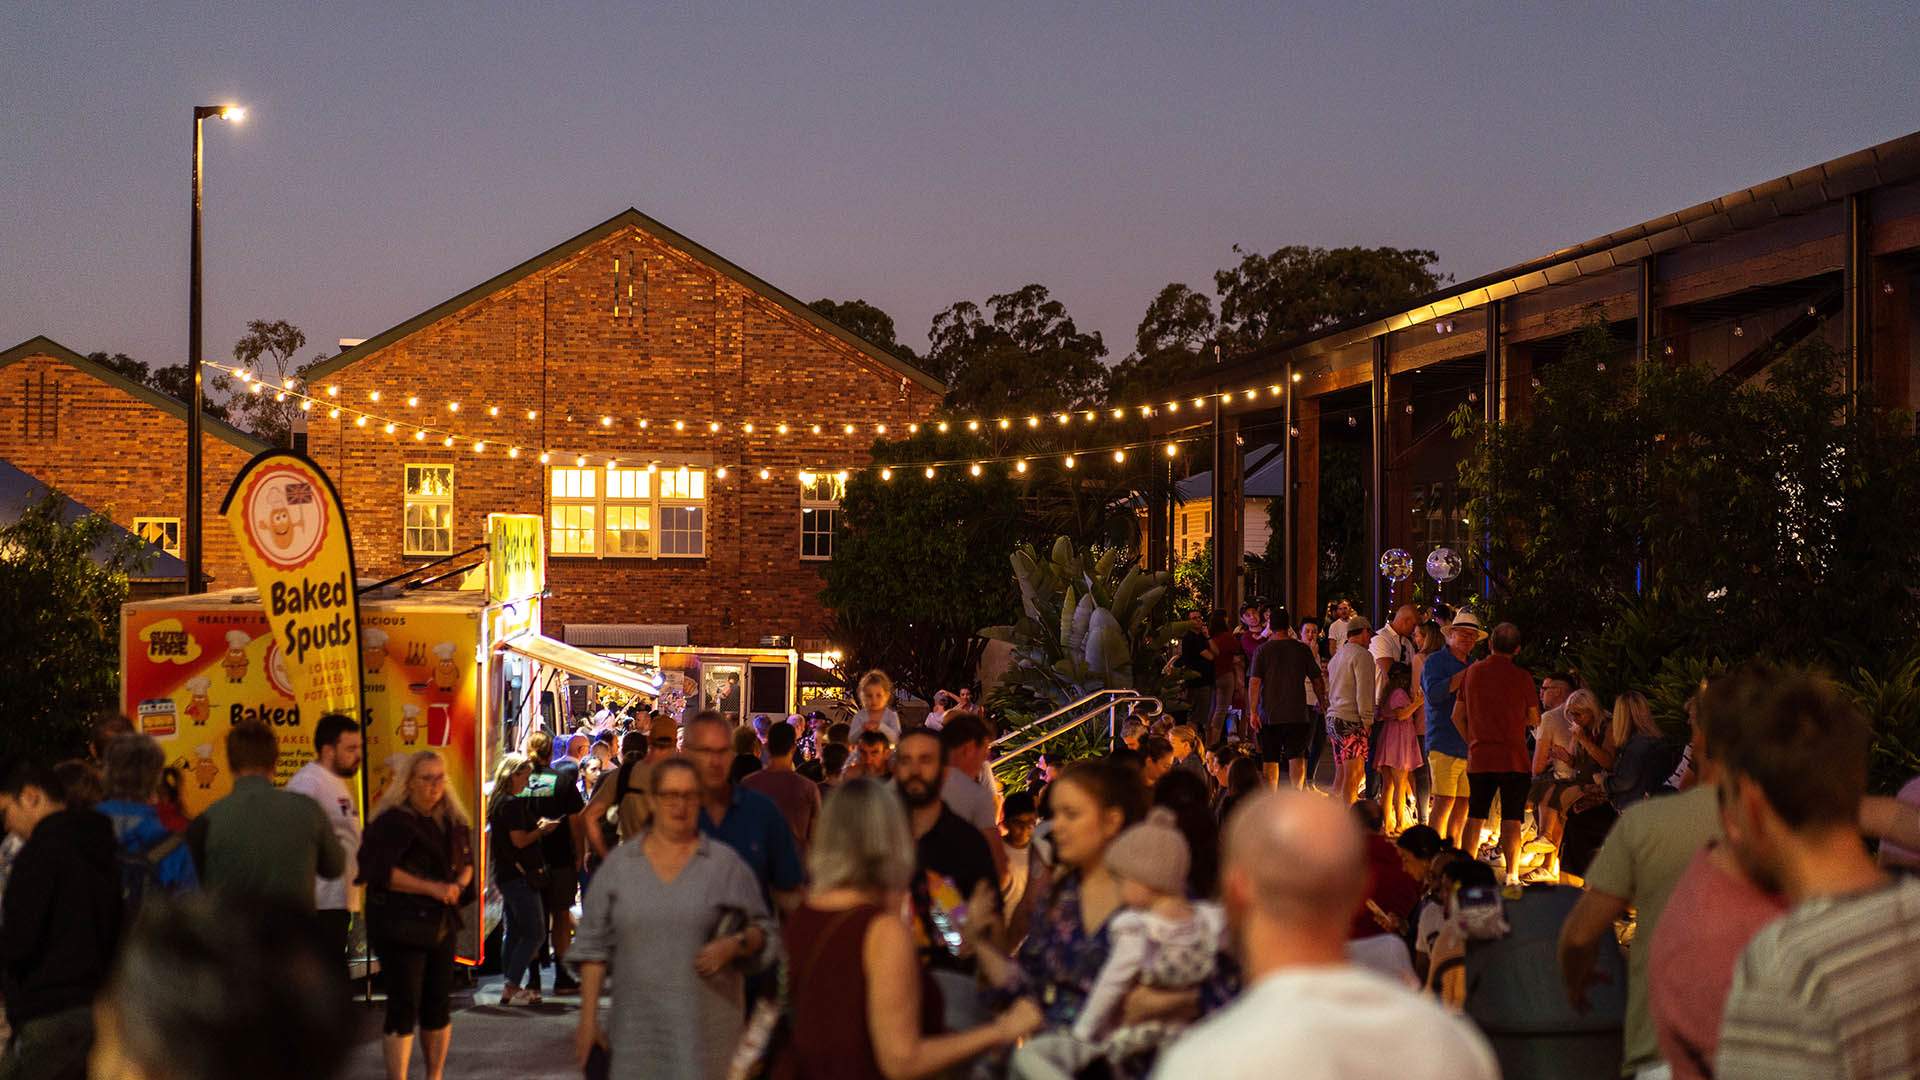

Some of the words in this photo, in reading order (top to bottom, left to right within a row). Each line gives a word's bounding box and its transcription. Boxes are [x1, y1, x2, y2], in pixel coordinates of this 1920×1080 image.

[271, 571, 347, 616] Baked
[197, 616, 248, 624] HEALTHY
[361, 617, 406, 626] LICIOUS
[151, 640, 188, 655] FREE
[285, 613, 351, 664] Spuds
[230, 703, 300, 726] Baked
